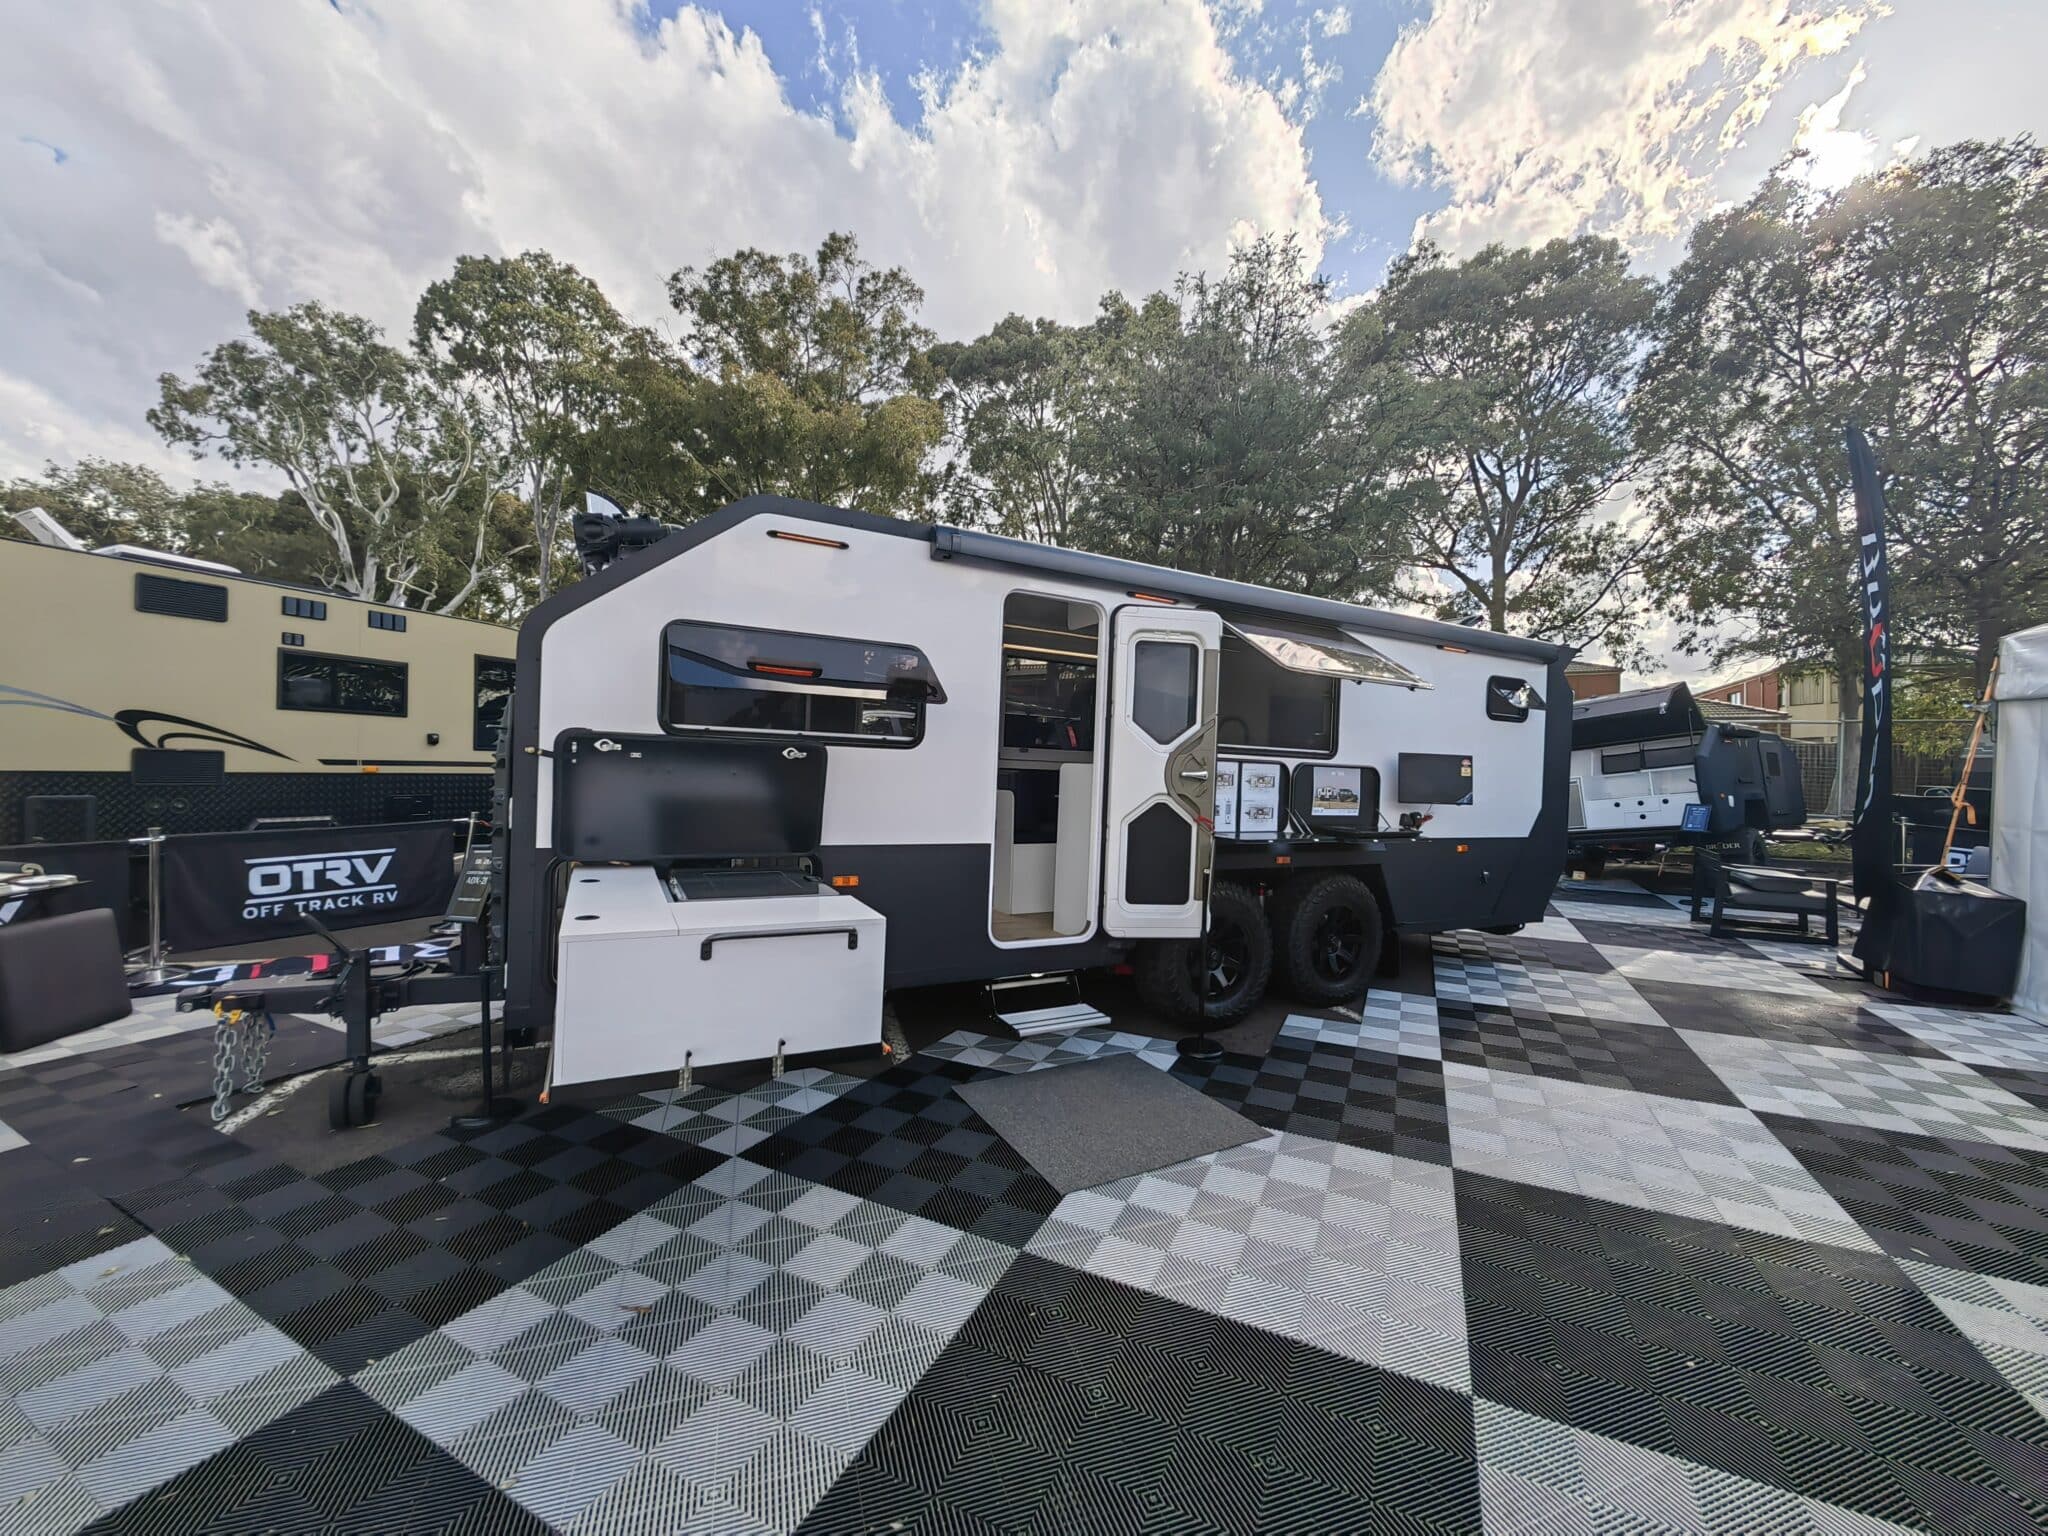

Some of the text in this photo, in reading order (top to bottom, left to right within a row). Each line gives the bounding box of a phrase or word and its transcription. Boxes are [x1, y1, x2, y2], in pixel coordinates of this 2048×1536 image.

[248, 855, 392, 895] OTRV
[242, 890, 398, 919] OFF TRACK RV
